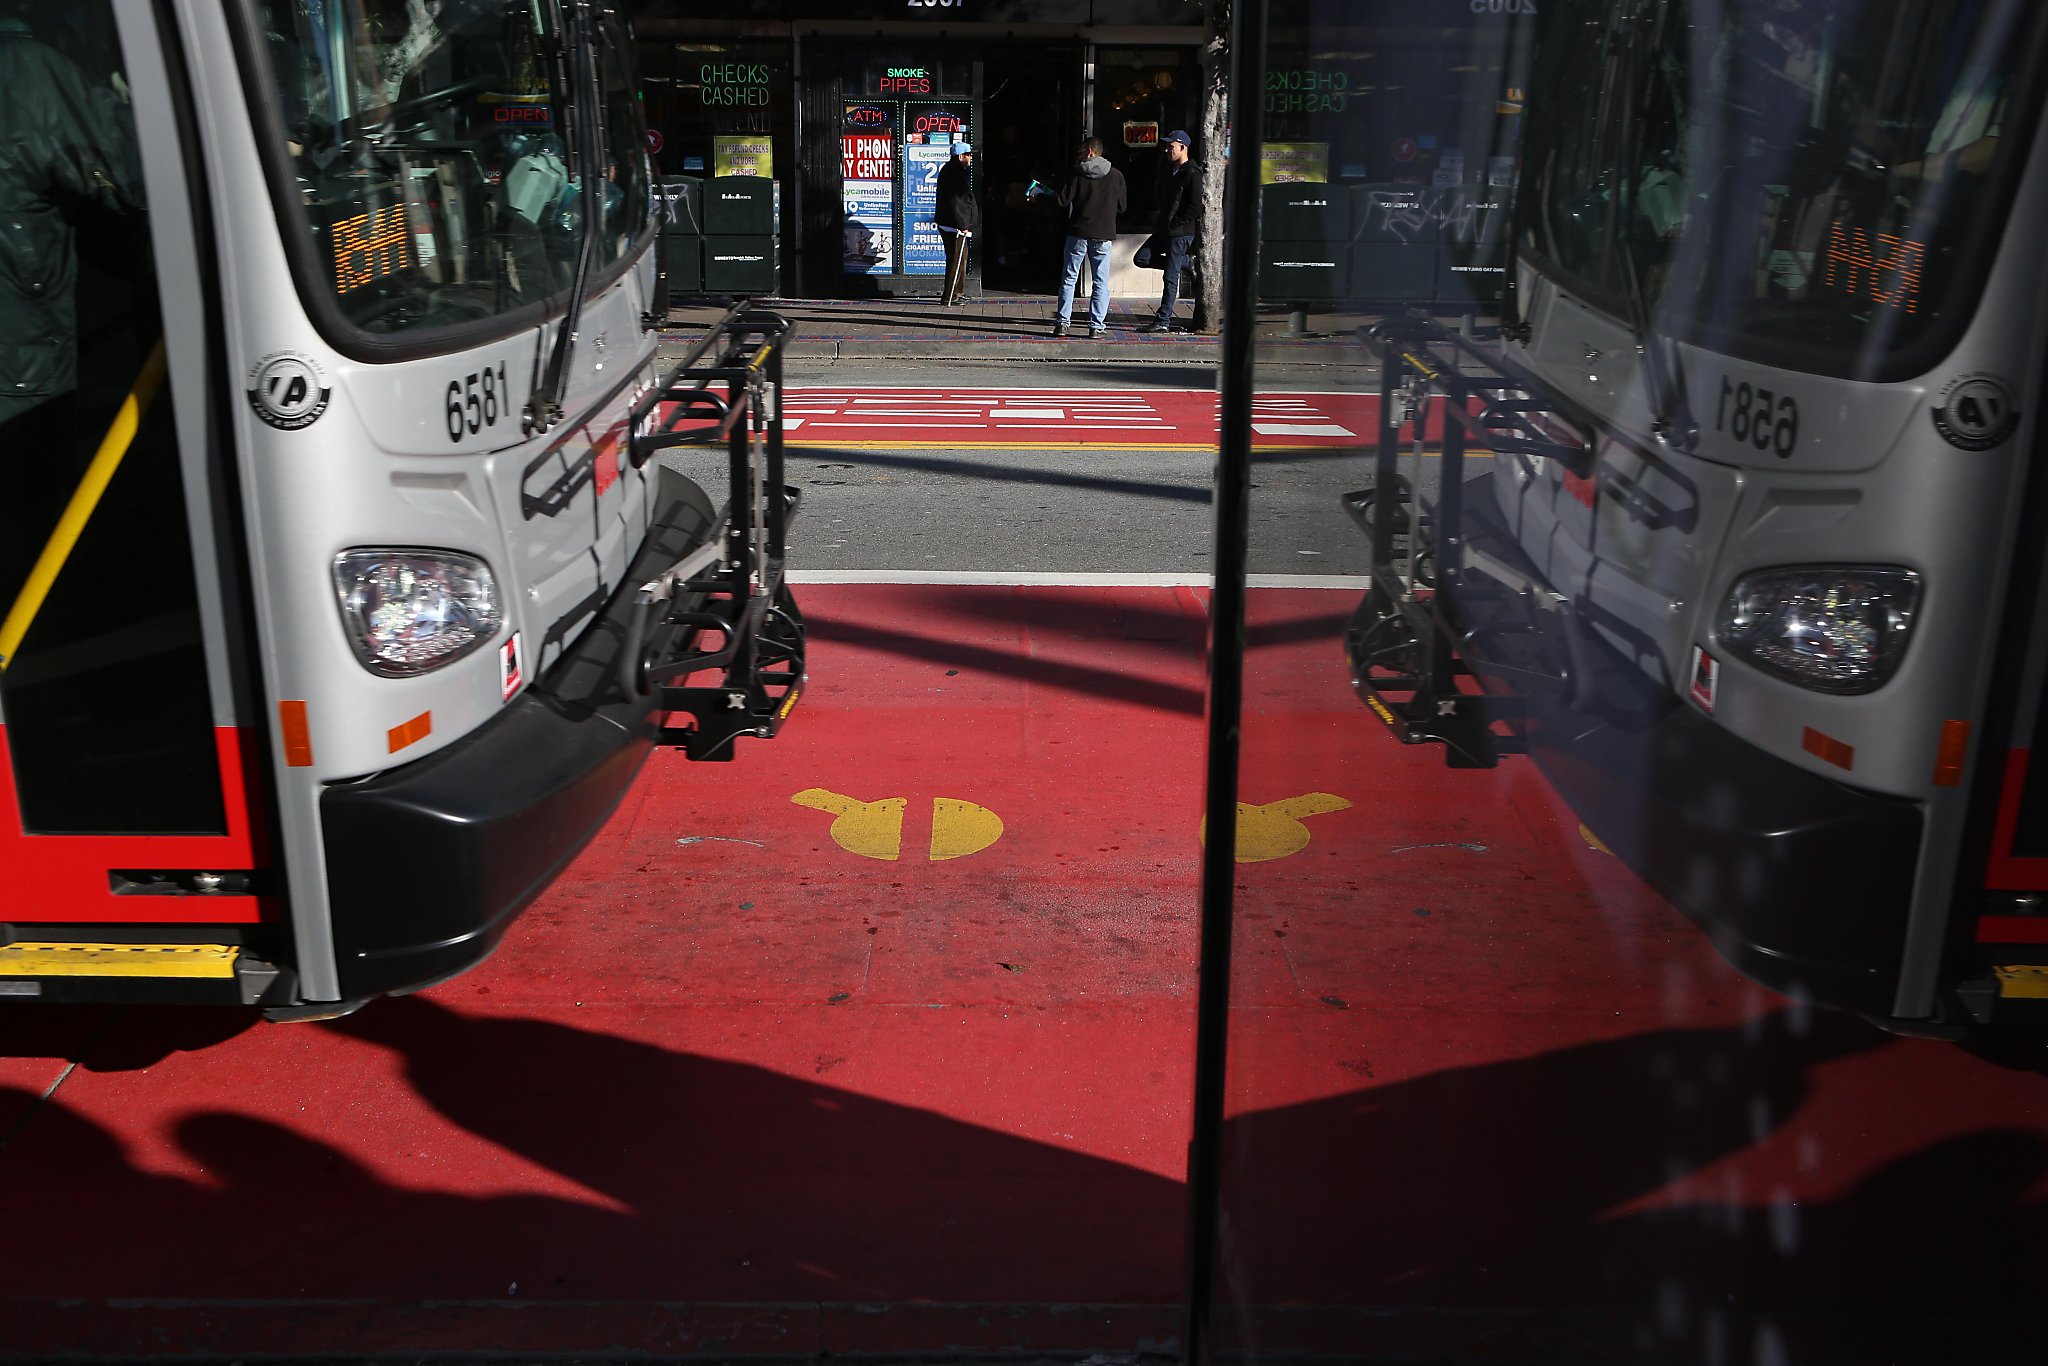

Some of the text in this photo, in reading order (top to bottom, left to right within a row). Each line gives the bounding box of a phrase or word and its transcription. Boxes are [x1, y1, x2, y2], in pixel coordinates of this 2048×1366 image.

[701, 64, 769, 83] CHECKS
[887, 68, 924, 77] SMOKE
[880, 78, 930, 93] PIPES
[702, 87, 769, 105] CASHED
[495, 109, 548, 122] OPEN
[854, 110, 882, 121] ATM
[916, 117, 960, 132] OPEN
[749, 144, 769, 153] CHECKS
[843, 139, 897, 158] LL PHONE
[730, 168, 758, 176] CASHED
[857, 160, 897, 177] CENTER
[844, 188, 890, 196] ycamobile
[446, 360, 510, 443] 6581
